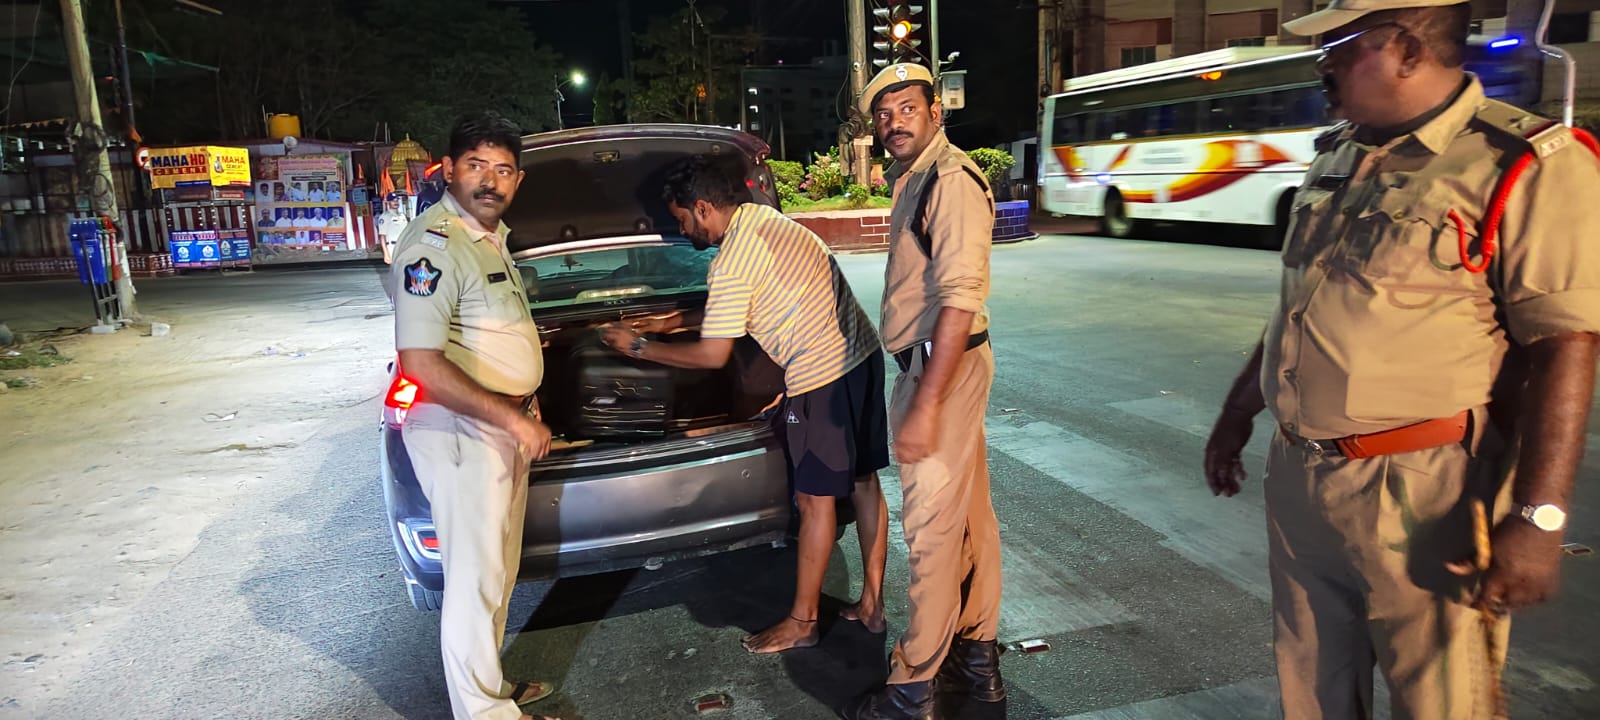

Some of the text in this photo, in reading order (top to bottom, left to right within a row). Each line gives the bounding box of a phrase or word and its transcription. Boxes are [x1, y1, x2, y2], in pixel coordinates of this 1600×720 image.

[151, 153, 206, 168] MAHA HD
[221, 155, 246, 164] MAHA
[156, 167, 204, 175] CEMENT
